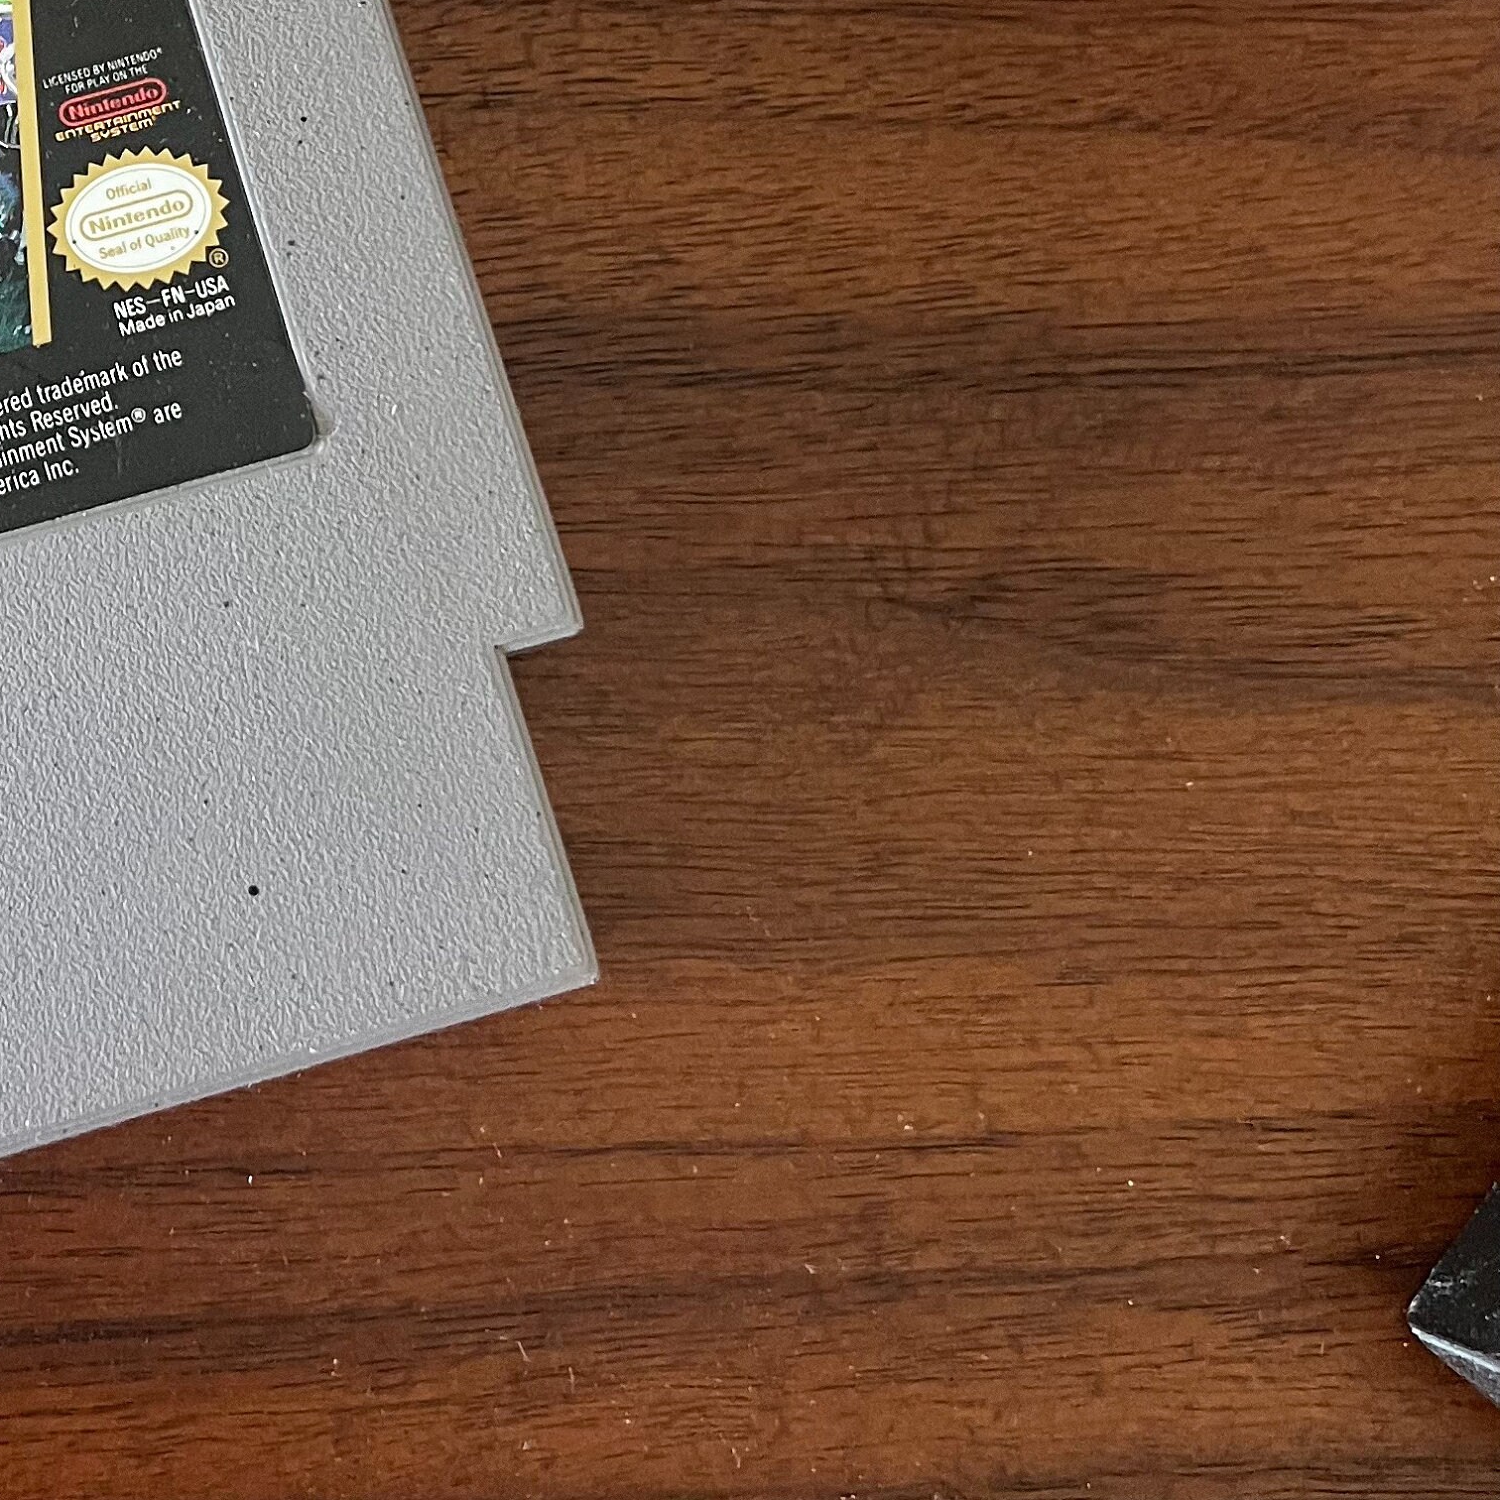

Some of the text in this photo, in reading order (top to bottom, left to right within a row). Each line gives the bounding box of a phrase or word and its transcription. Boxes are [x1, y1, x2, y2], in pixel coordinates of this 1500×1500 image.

[42, 66, 91, 89] LICENSED
[93, 63, 105, 76] BY
[65, 63, 148, 95] FOR PLAY ON THE
[68, 87, 159, 121] Nintendo
[105, 178, 152, 200] Official
[88, 199, 185, 235] Nintendo
[100, 226, 190, 260] Seal of Quality
[119, 294, 236, 337] Made in Japan
[36, 362, 129, 402] trademark
[133, 355, 148, 378] of
[153, 349, 183, 372] the
[30, 391, 119, 433] Reserved.
[153, 402, 183, 424] are
[43, 458, 80, 481] Inc.
